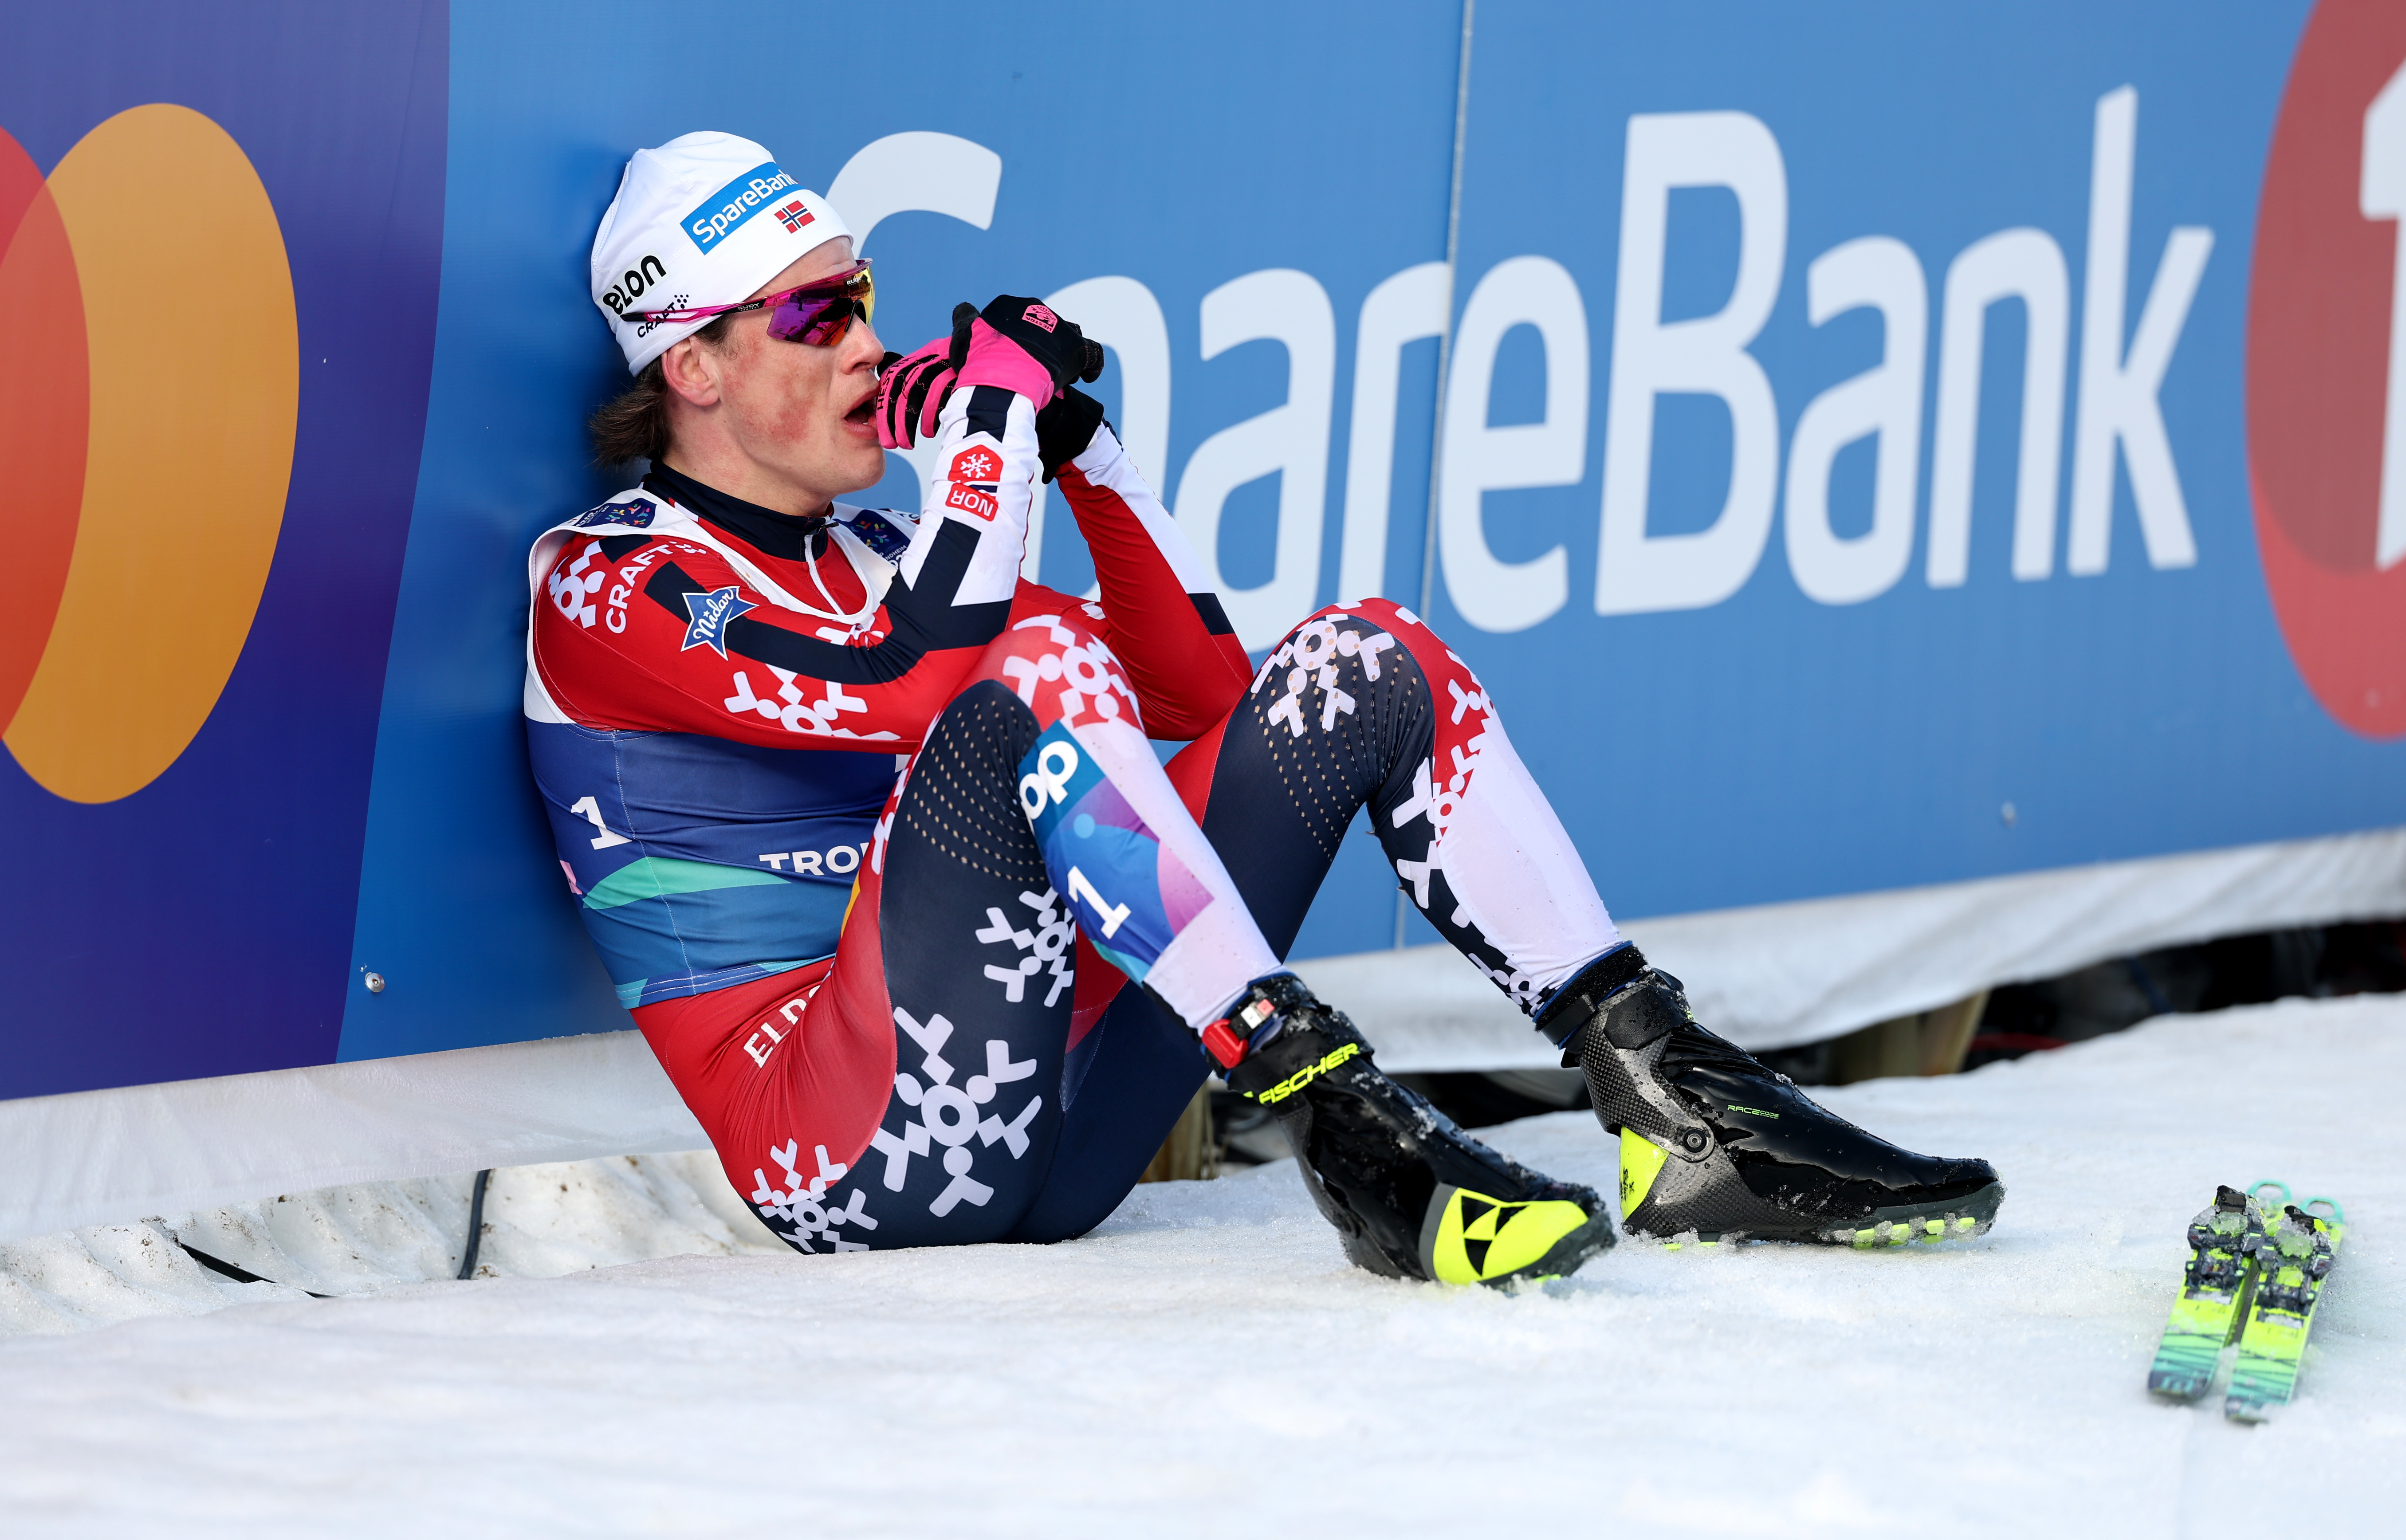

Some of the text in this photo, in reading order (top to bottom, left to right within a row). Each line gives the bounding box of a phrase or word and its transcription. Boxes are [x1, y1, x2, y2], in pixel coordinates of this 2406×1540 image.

[692, 169, 798, 244] SpareBank
[637, 302, 675, 338] CRAFT
[1025, 316, 1052, 331] HESTRA
[950, 490, 994, 517] NOR
[885, 545, 907, 560] NDHEIM
[606, 544, 673, 633] CRAFT
[1019, 740, 1079, 835] op
[571, 797, 632, 850] 1
[1067, 866, 1131, 939] 1
[1258, 1042, 1360, 1105] FISCHER
